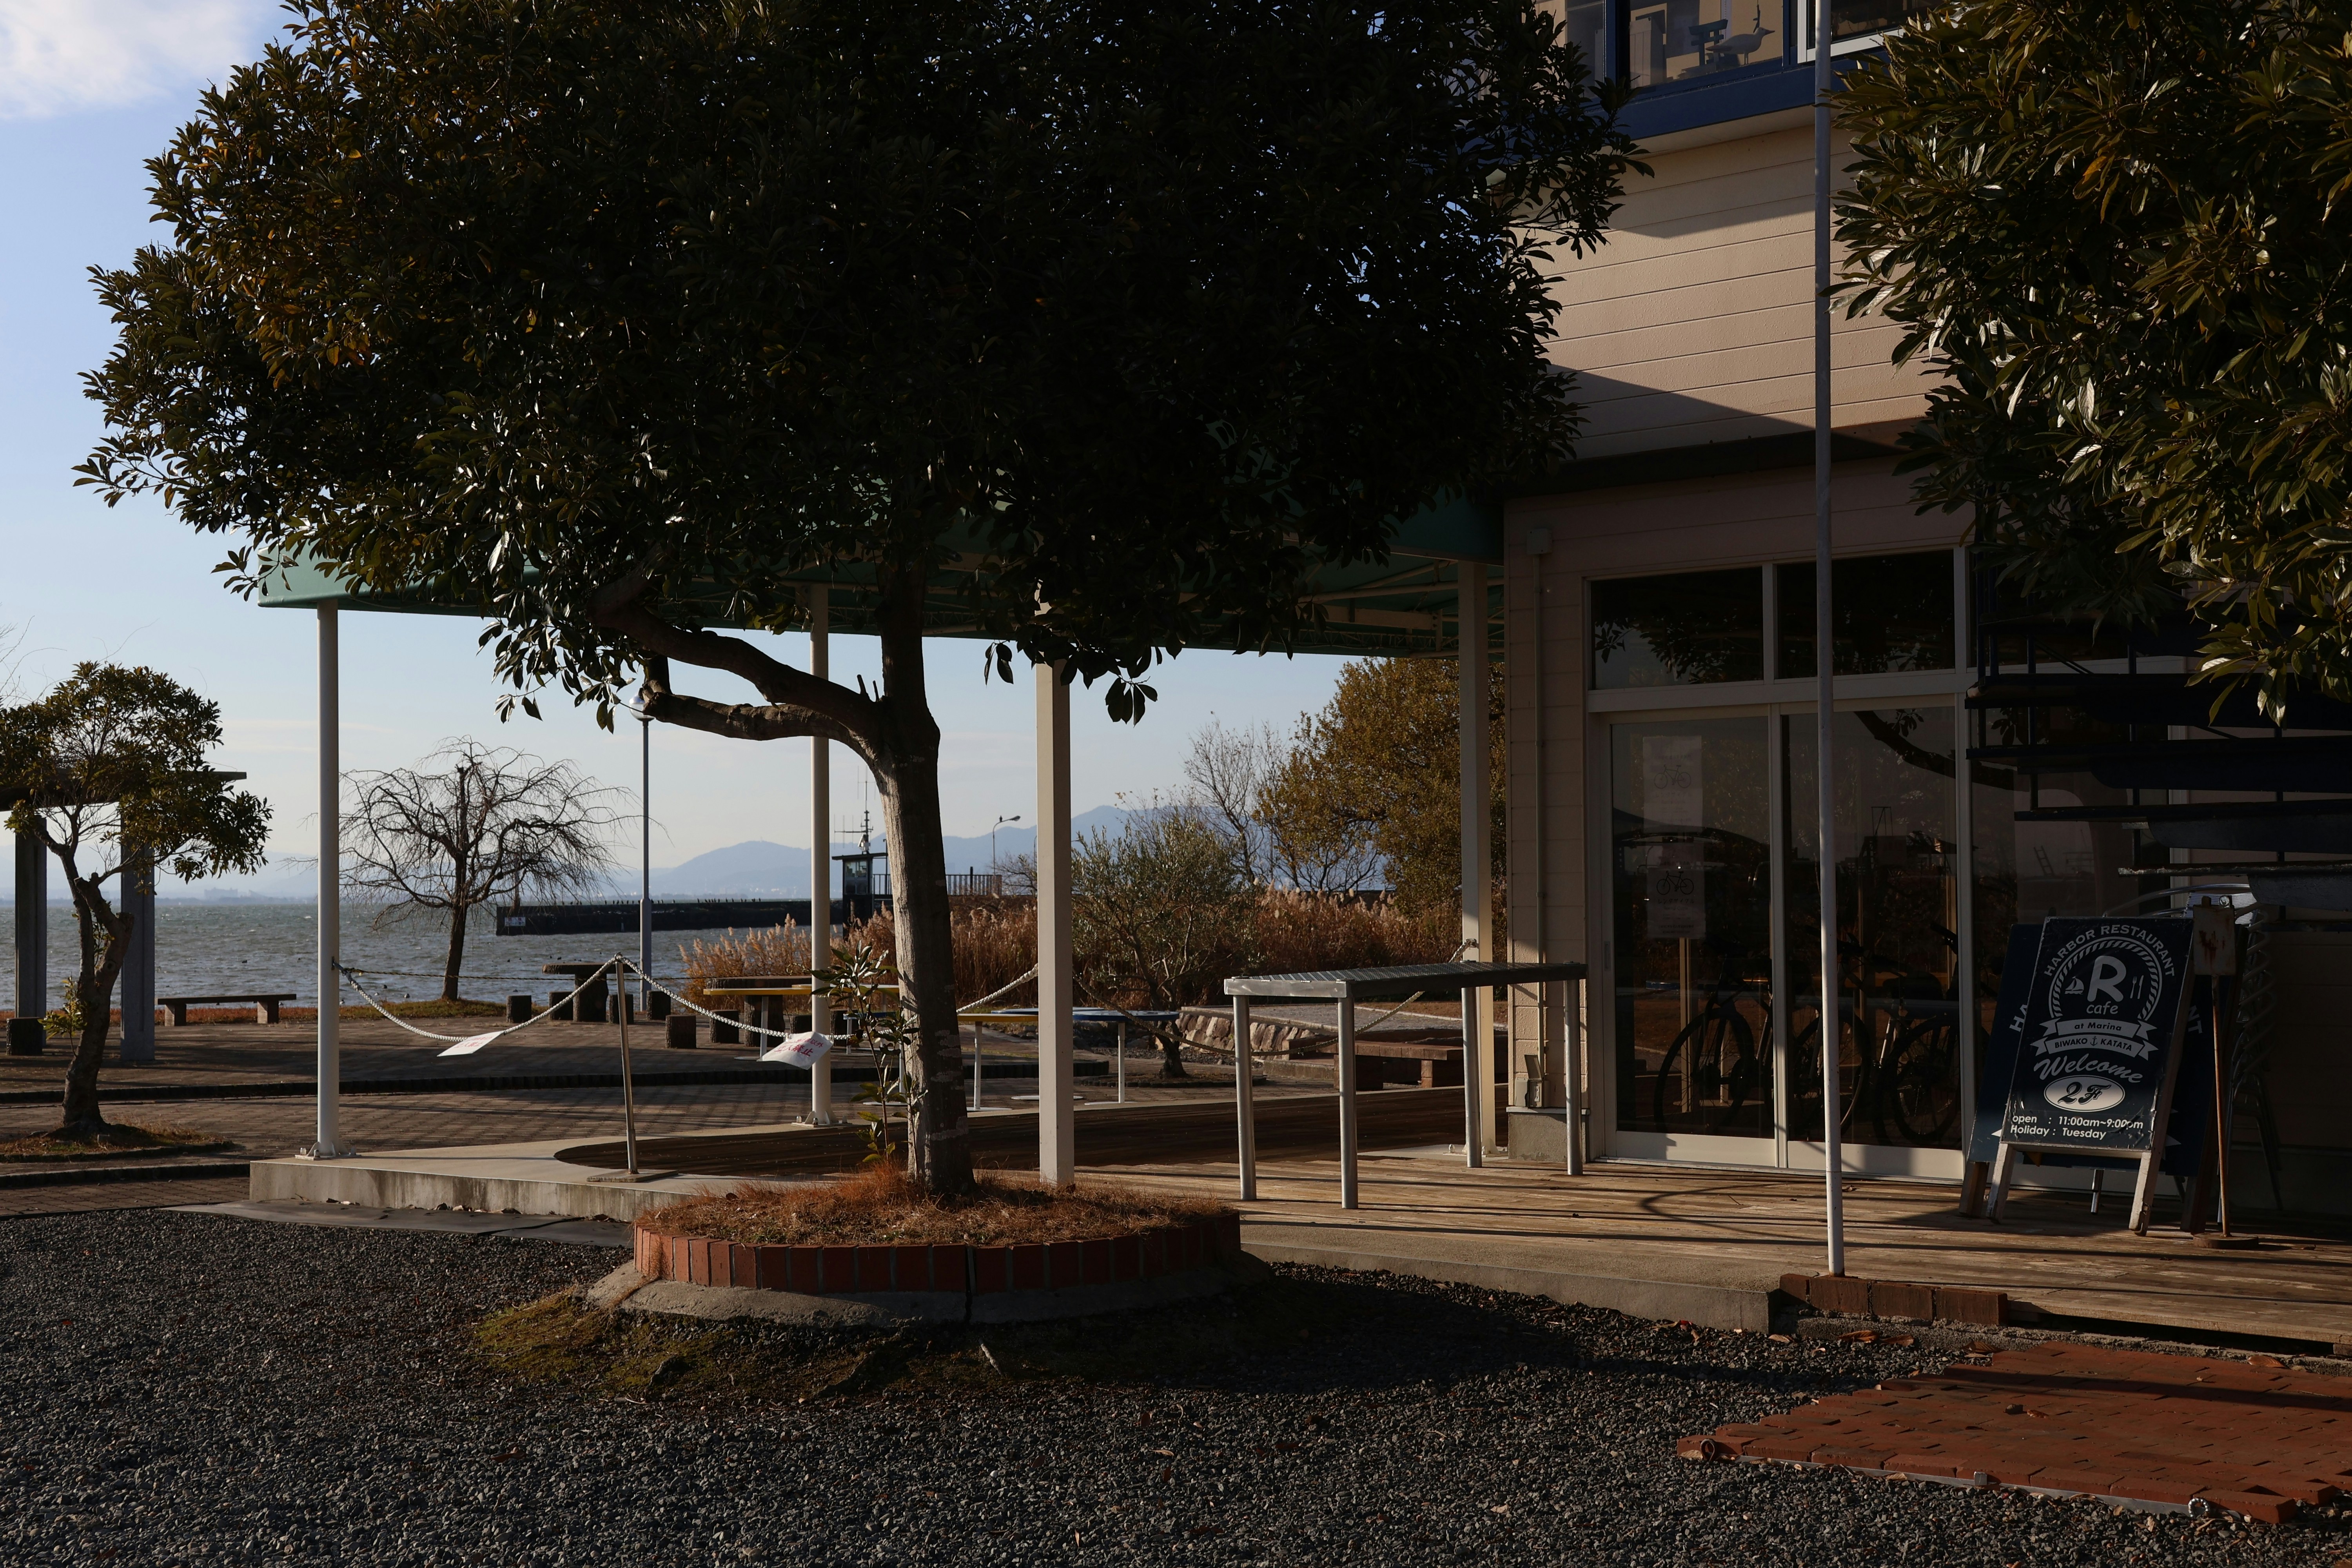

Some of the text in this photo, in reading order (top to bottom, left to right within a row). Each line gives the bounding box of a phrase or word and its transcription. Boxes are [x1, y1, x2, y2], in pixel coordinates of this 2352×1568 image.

[2043, 924, 2175, 976] HARBOR RESTAURANT
[2087, 955, 2127, 1002] R
[2086, 1001, 2119, 1015] cafe
[2087, 1022, 2122, 1031] Marina
[774, 1044, 813, 1057] 立入禁止
[2054, 1038, 2132, 1051] BIWAKO KATATA
[2033, 1053, 2143, 1083] Welcome
[2057, 1082, 2111, 1105] 2F
[2012, 1115, 2037, 1125] open
[2010, 1125, 2050, 1137] Holiday
[2062, 1127, 2107, 1140] Tuesday
